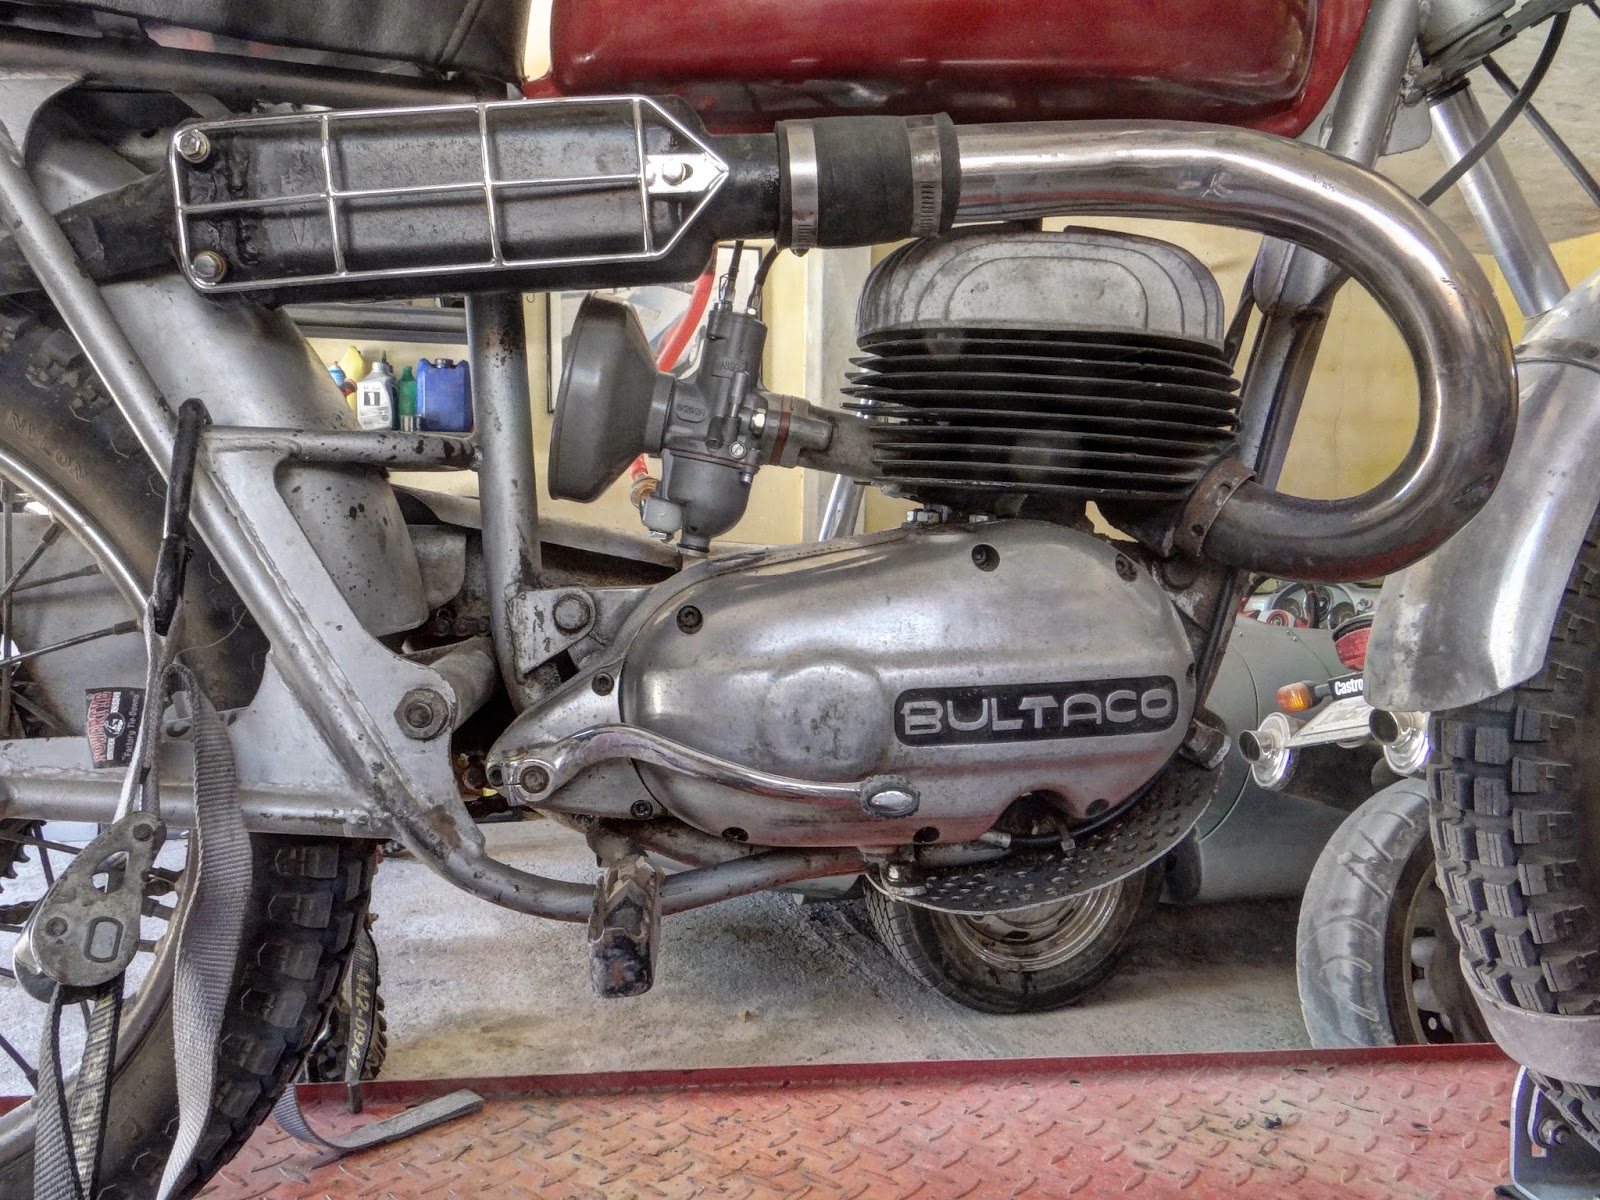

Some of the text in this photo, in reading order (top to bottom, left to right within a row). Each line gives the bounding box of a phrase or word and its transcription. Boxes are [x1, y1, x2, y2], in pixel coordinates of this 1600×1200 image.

[8, 410, 88, 480] NYLON
[900, 687, 1172, 735] BULTACO
[1334, 678, 1364, 696] Castro
